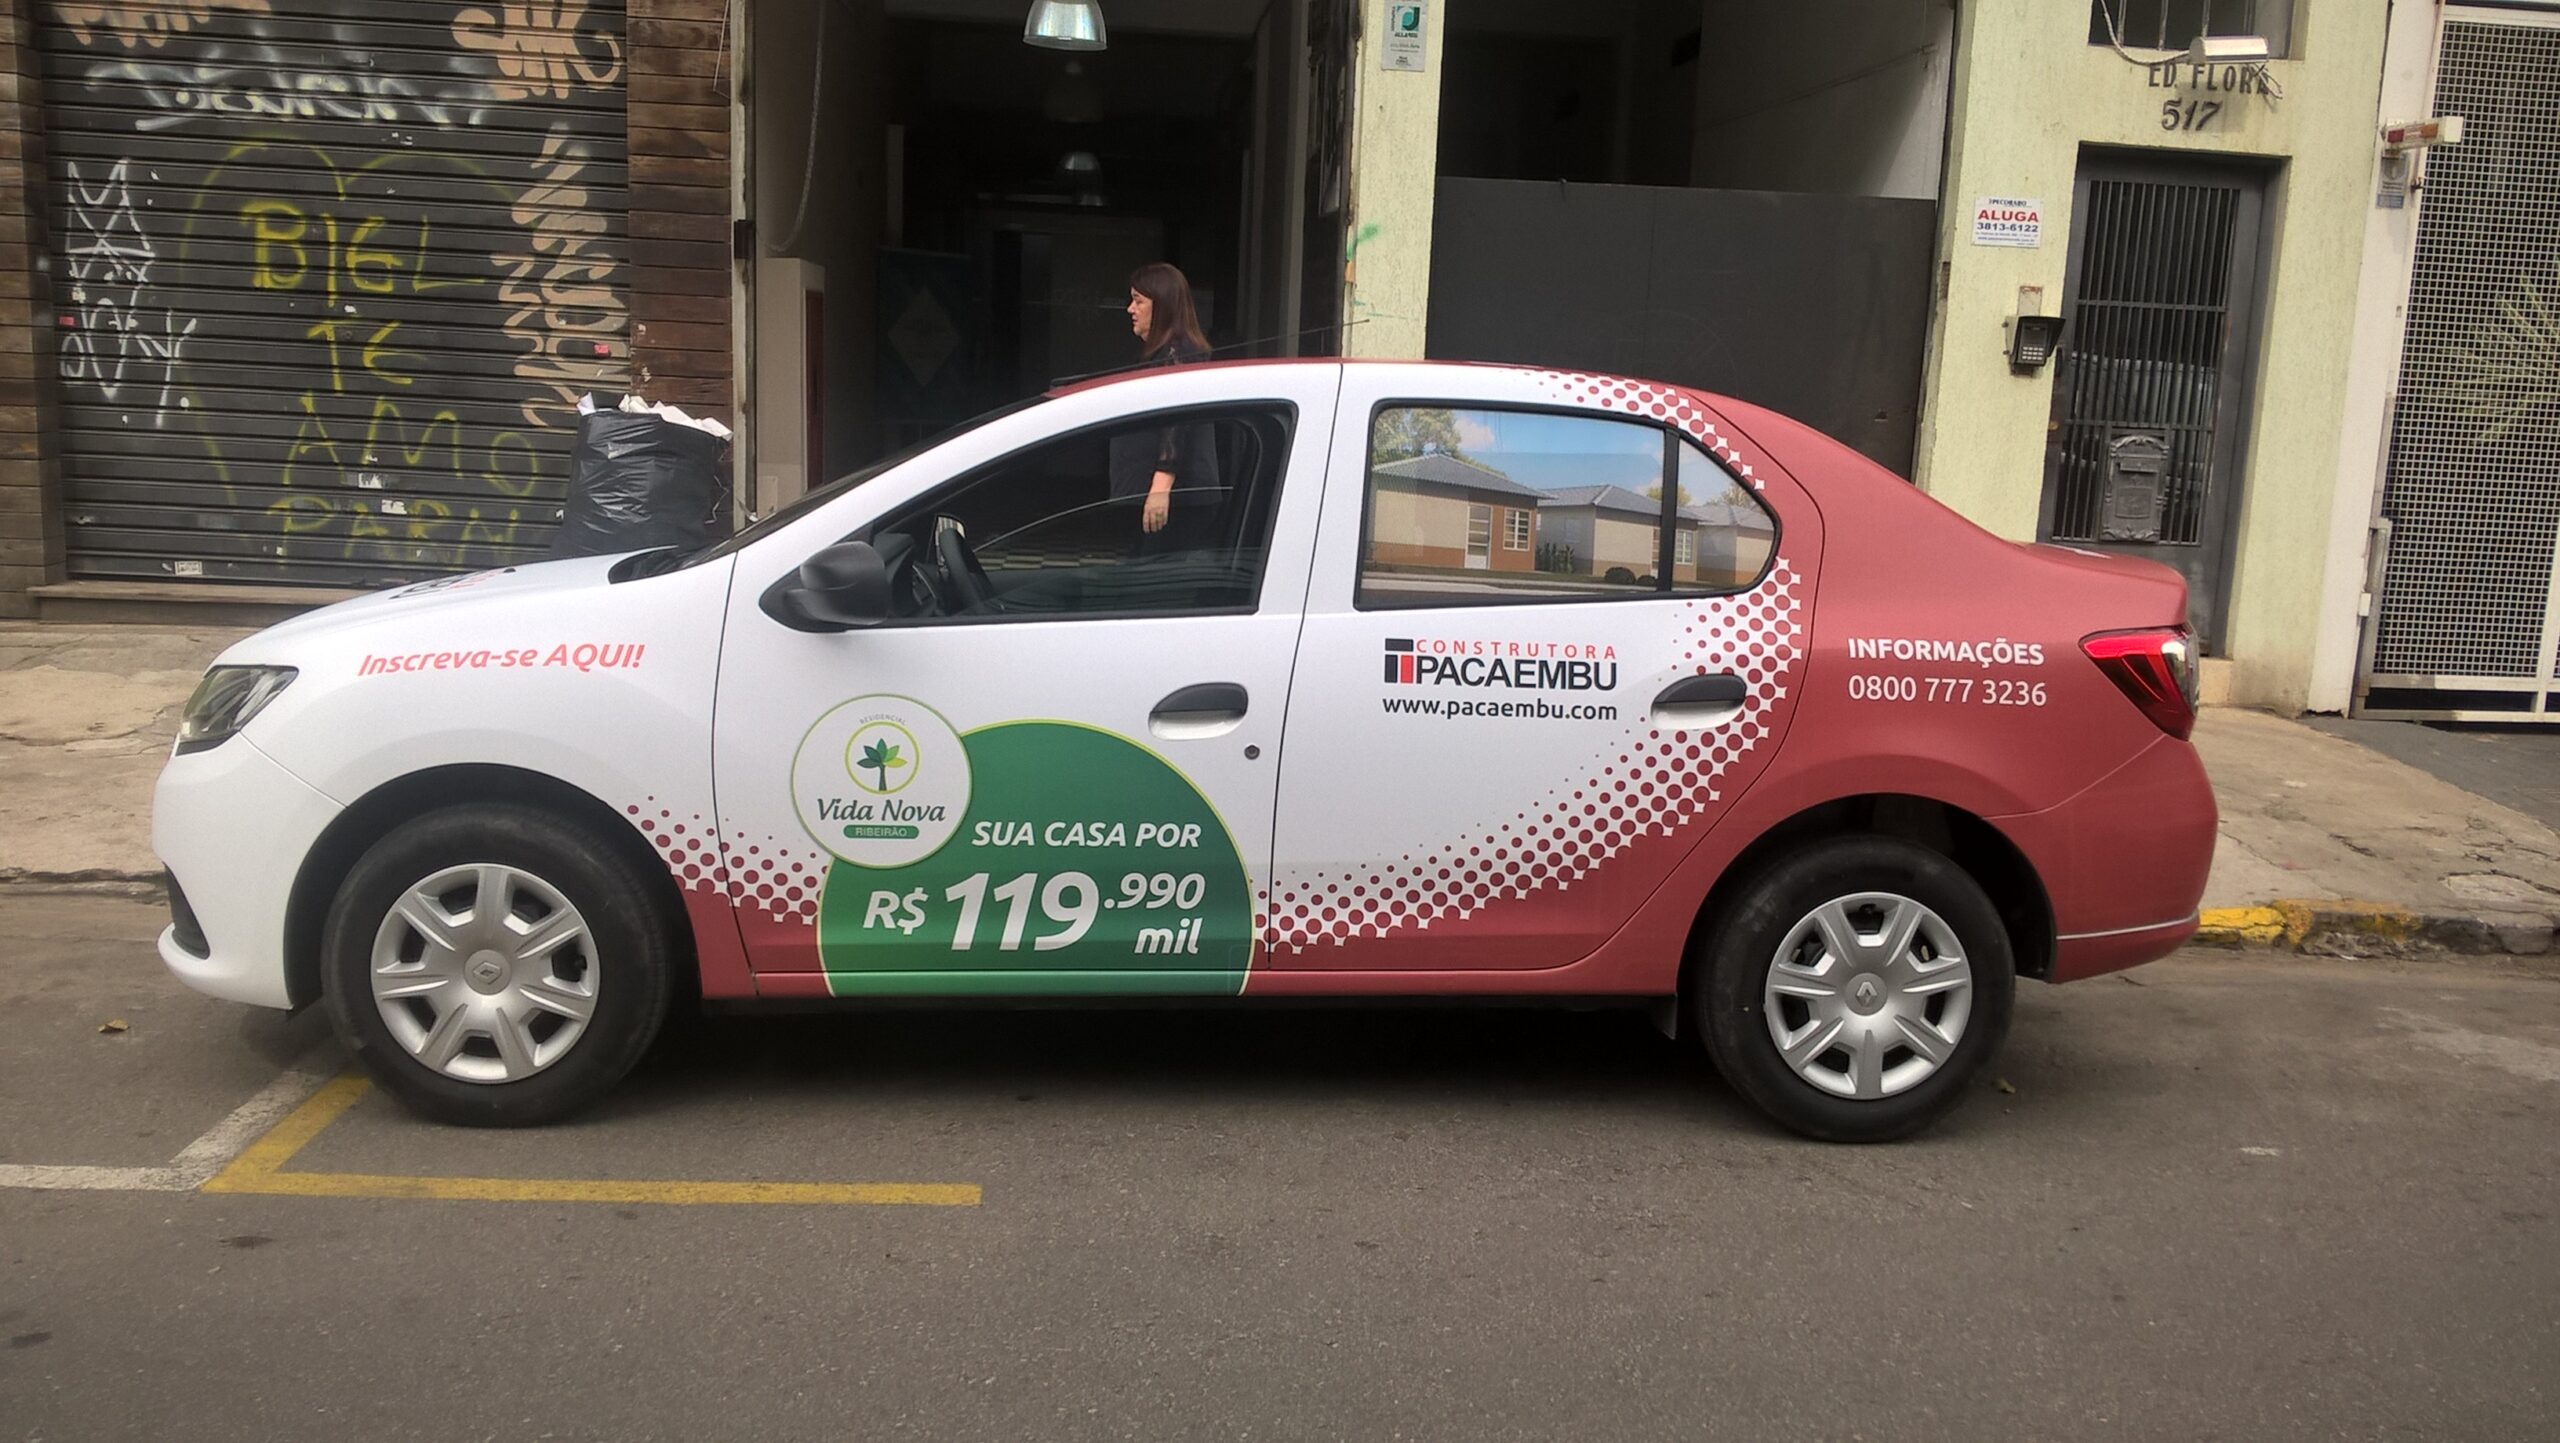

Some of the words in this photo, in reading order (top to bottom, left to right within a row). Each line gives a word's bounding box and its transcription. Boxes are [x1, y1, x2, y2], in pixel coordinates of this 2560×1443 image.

[2161, 98, 2223, 131] 517
[1977, 209, 2039, 223] ALUGA
[1977, 222, 2039, 233] 3813-6122
[306, 319, 427, 394] TE
[281, 391, 541, 497] AMO
[357, 648, 539, 676] Inscreva-se
[542, 643, 646, 672] AQUI!
[1415, 639, 1617, 660] CONSTRUTORA
[1848, 637, 2045, 668] INFORMAÇÕES
[1416, 655, 1618, 691] PACAEMBU
[1849, 675, 1917, 701] 0800
[1924, 678, 1974, 703] 777
[1982, 679, 2048, 706] 3236
[1383, 697, 1618, 720] www.pacaembu.com
[817, 798, 873, 821] Vida
[881, 799, 946, 822] Nova
[855, 827, 908, 837] RIBEIRÃO
[972, 821, 1036, 847] SUA
[1044, 822, 1127, 848] CASA
[1135, 823, 1202, 848] POR
[862, 887, 929, 935] R$
[1134, 916, 1203, 955] mil
